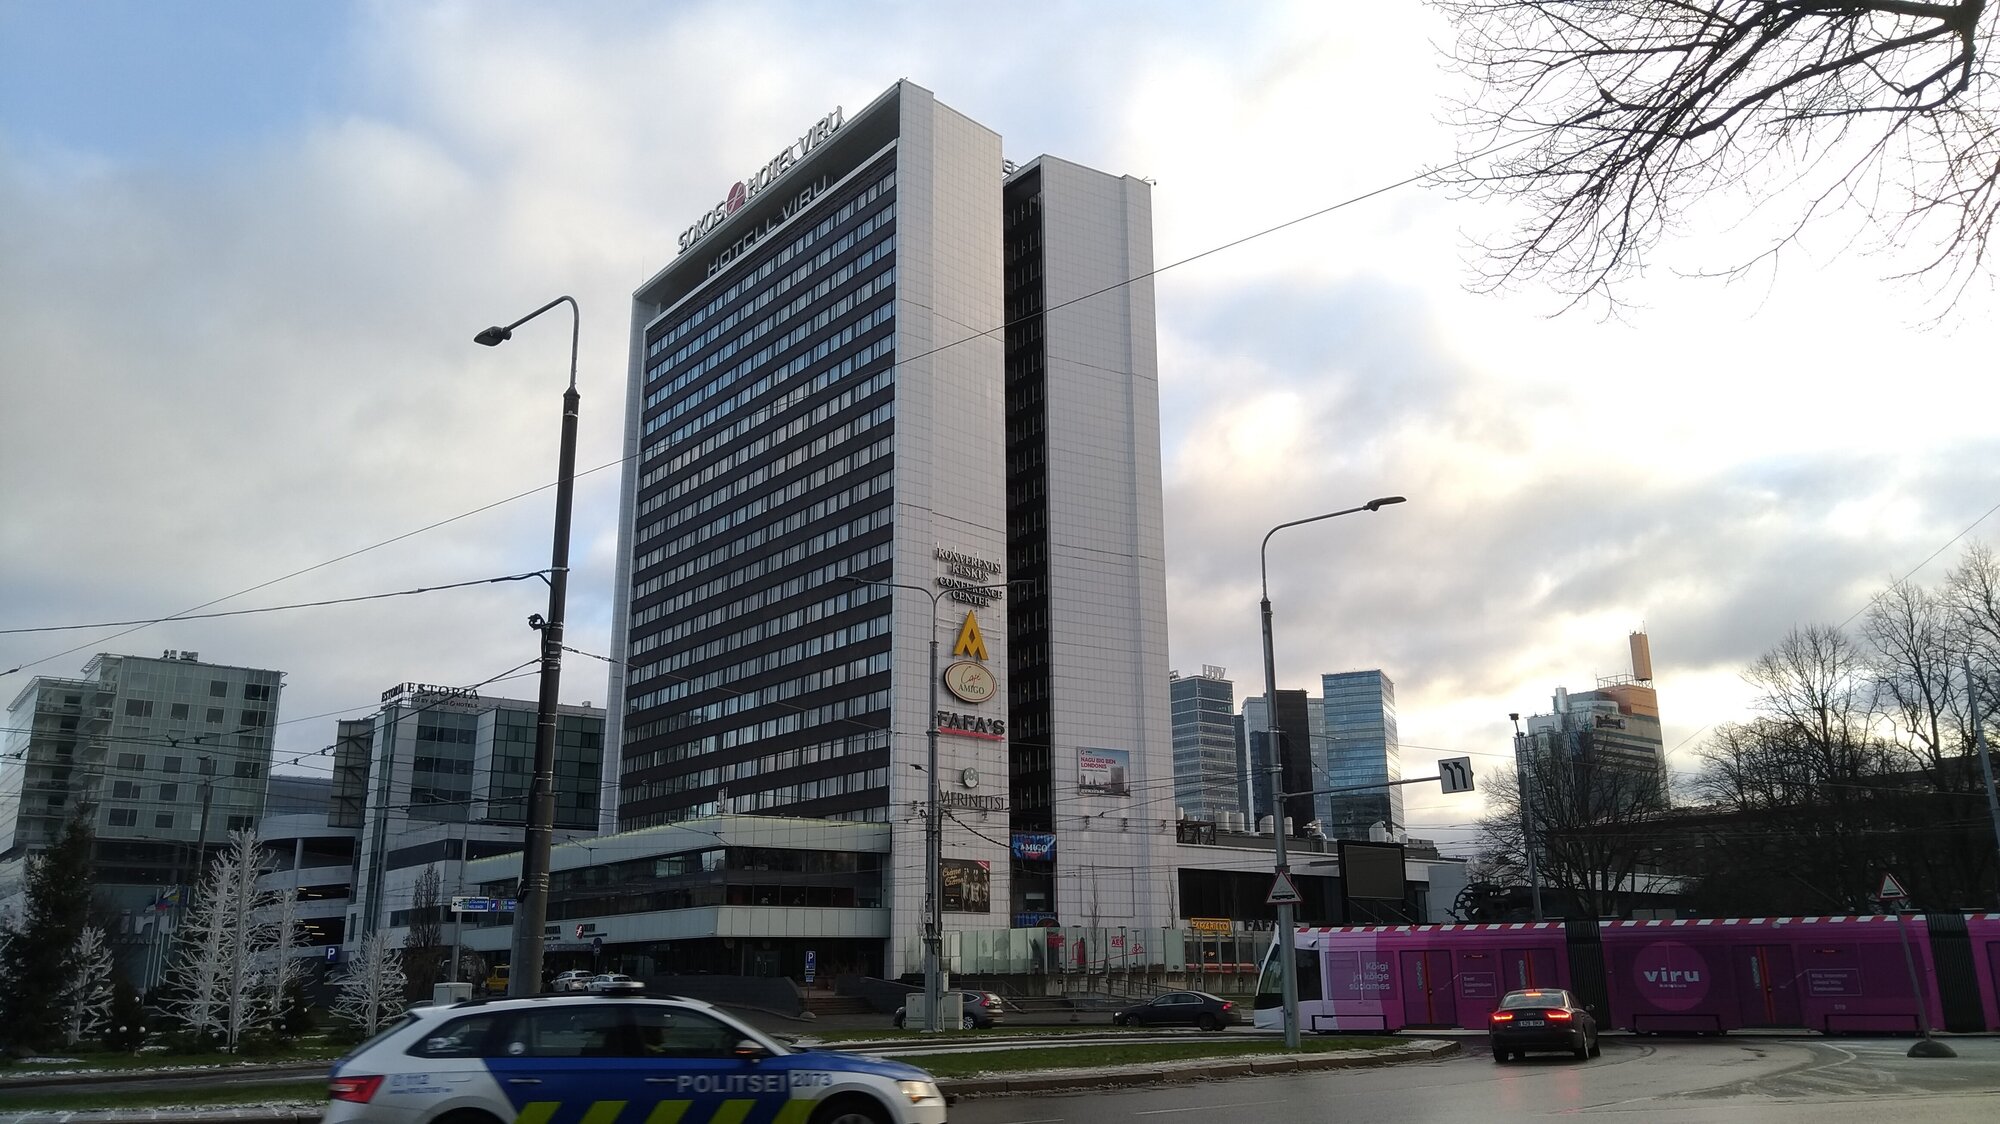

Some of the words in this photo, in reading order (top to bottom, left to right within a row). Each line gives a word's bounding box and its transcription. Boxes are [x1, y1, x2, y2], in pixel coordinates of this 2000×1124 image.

[678, 200, 727, 255] SOKOS
[747, 146, 797, 199] HOTEL
[798, 105, 844, 156] VIRU
[708, 218, 777, 278] HOTELL
[782, 175, 827, 220] VIRU
[937, 548, 1001, 573] KONVERENTSI
[951, 562, 990, 581] KESKUS
[938, 576, 1002, 599] CONFERENCE
[952, 590, 990, 607] CENTER
[1202, 664, 1226, 679] LHV
[407, 682, 479, 700] ESTORIA
[958, 684, 985, 694] AMIGO
[938, 711, 1006, 735] FAFA'S
[327, 948, 336, 959] P
[808, 952, 814, 962] P
[1365, 961, 1388, 972] Kõigi
[1643, 967, 1700, 982] viru
[1364, 972, 1389, 981] kõige
[677, 1074, 787, 1093] POLITSEI
